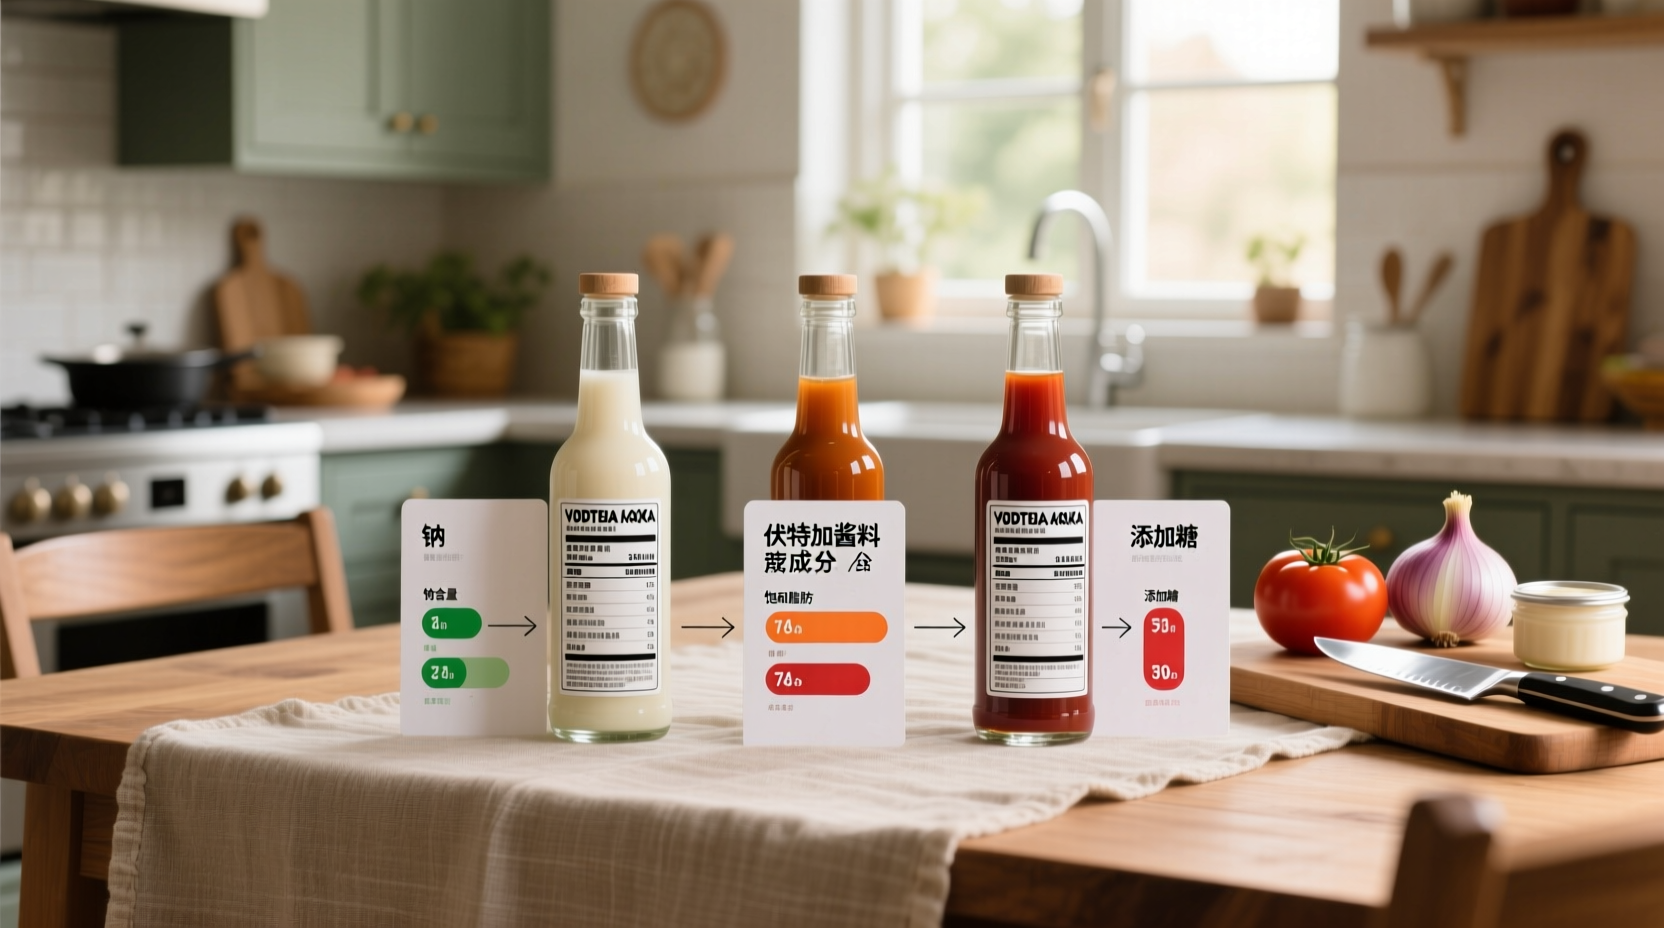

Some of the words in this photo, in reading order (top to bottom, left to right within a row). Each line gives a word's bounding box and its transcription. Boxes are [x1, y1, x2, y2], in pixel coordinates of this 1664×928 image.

[421, 523, 445, 548] 钠
[763, 521, 881, 548] 伏特加酱料
[1130, 523, 1199, 549] 添加糖
